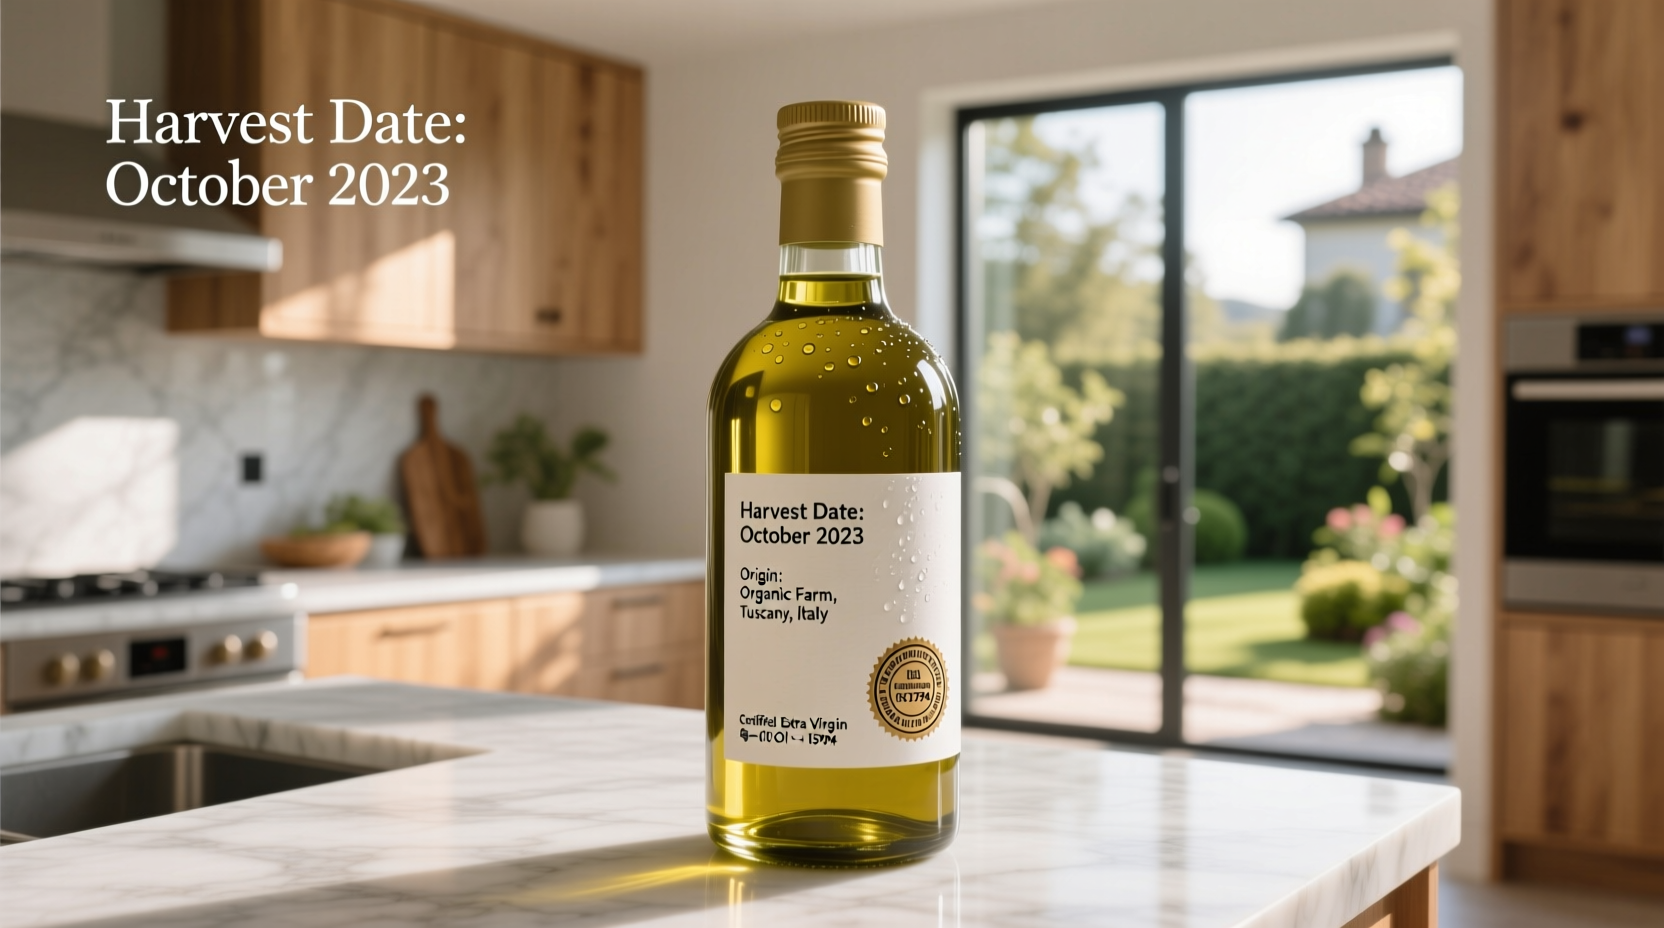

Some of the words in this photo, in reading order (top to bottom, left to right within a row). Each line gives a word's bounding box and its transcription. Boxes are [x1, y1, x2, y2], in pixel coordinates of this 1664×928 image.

[740, 501, 808, 520] Harvest
[813, 502, 864, 521] Date:
[740, 525, 811, 545] October
[816, 527, 864, 545] 2023
[740, 567, 783, 586] Origin:
[740, 585, 792, 604] Organic
[795, 587, 838, 604] Farm,
[740, 605, 794, 624] Tuscany,
[797, 606, 829, 624] Italy
[809, 717, 848, 734] Virgin
